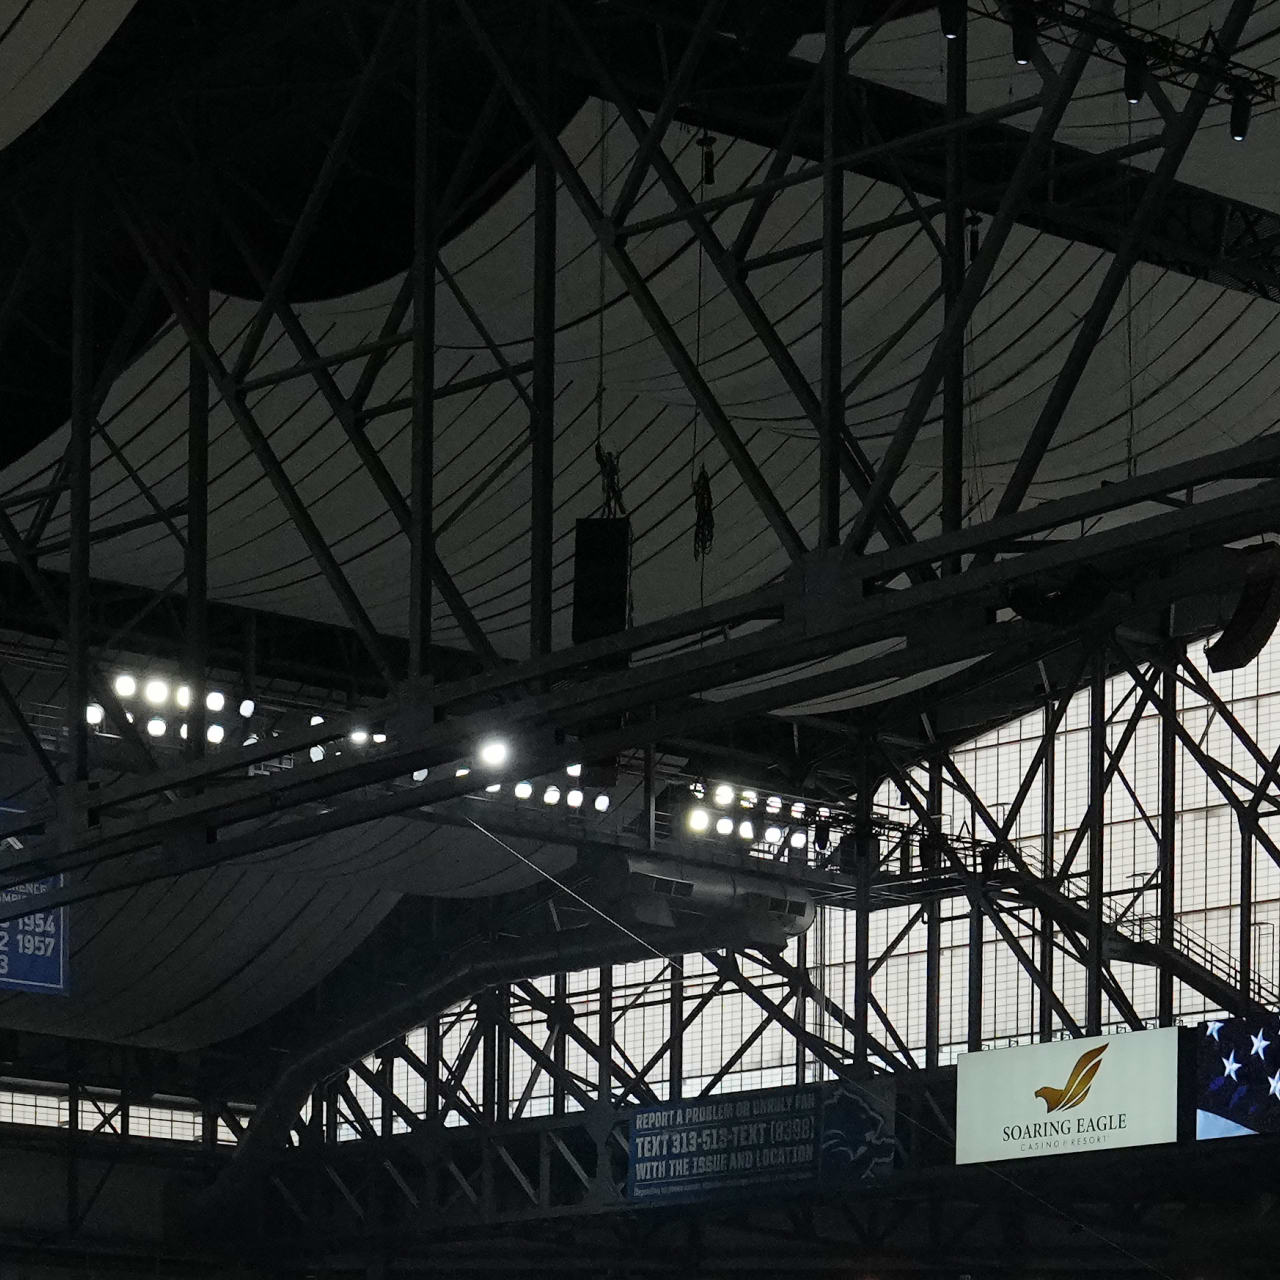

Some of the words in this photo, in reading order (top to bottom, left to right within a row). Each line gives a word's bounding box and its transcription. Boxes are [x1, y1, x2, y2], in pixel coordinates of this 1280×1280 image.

[17, 933, 56, 957] 1957
[636, 1110, 674, 1130] REPORT
[685, 1103, 733, 1124] PROBLEM
[1002, 1119, 1072, 1142] SOARING
[1076, 1113, 1127, 1134] EAGLE
[635, 1134, 669, 1159] TEXT
[1020, 1139, 1061, 1152] CASINO
[635, 1161, 667, 1181] WITH
[670, 1158, 690, 1176] THE
